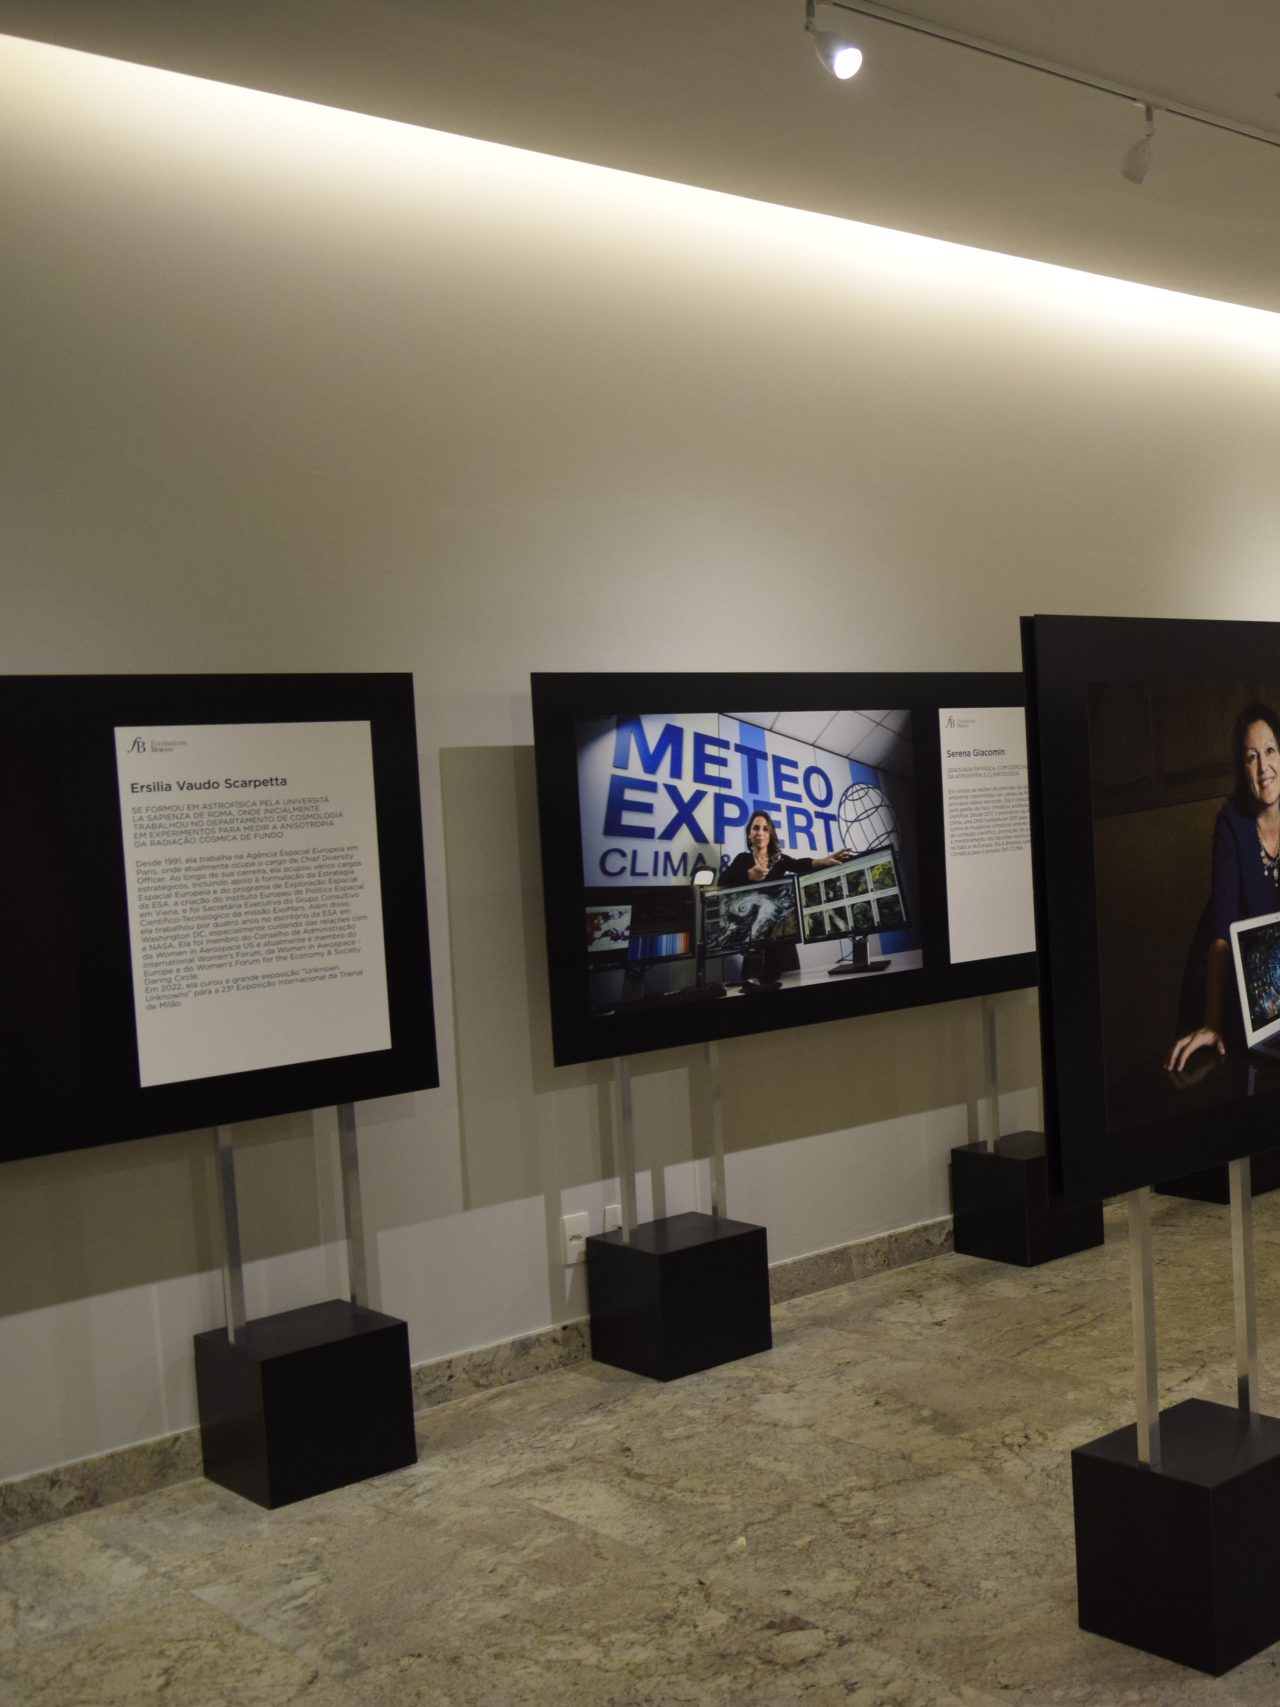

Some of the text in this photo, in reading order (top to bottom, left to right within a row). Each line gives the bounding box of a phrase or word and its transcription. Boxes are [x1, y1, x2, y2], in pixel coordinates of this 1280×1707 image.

[613, 714, 833, 808] METEO
[947, 747, 1005, 758] Serena Giacomin
[130, 776, 287, 792] Ersilia Vaudo Scarpetta
[599, 847, 706, 877] CLIMA
